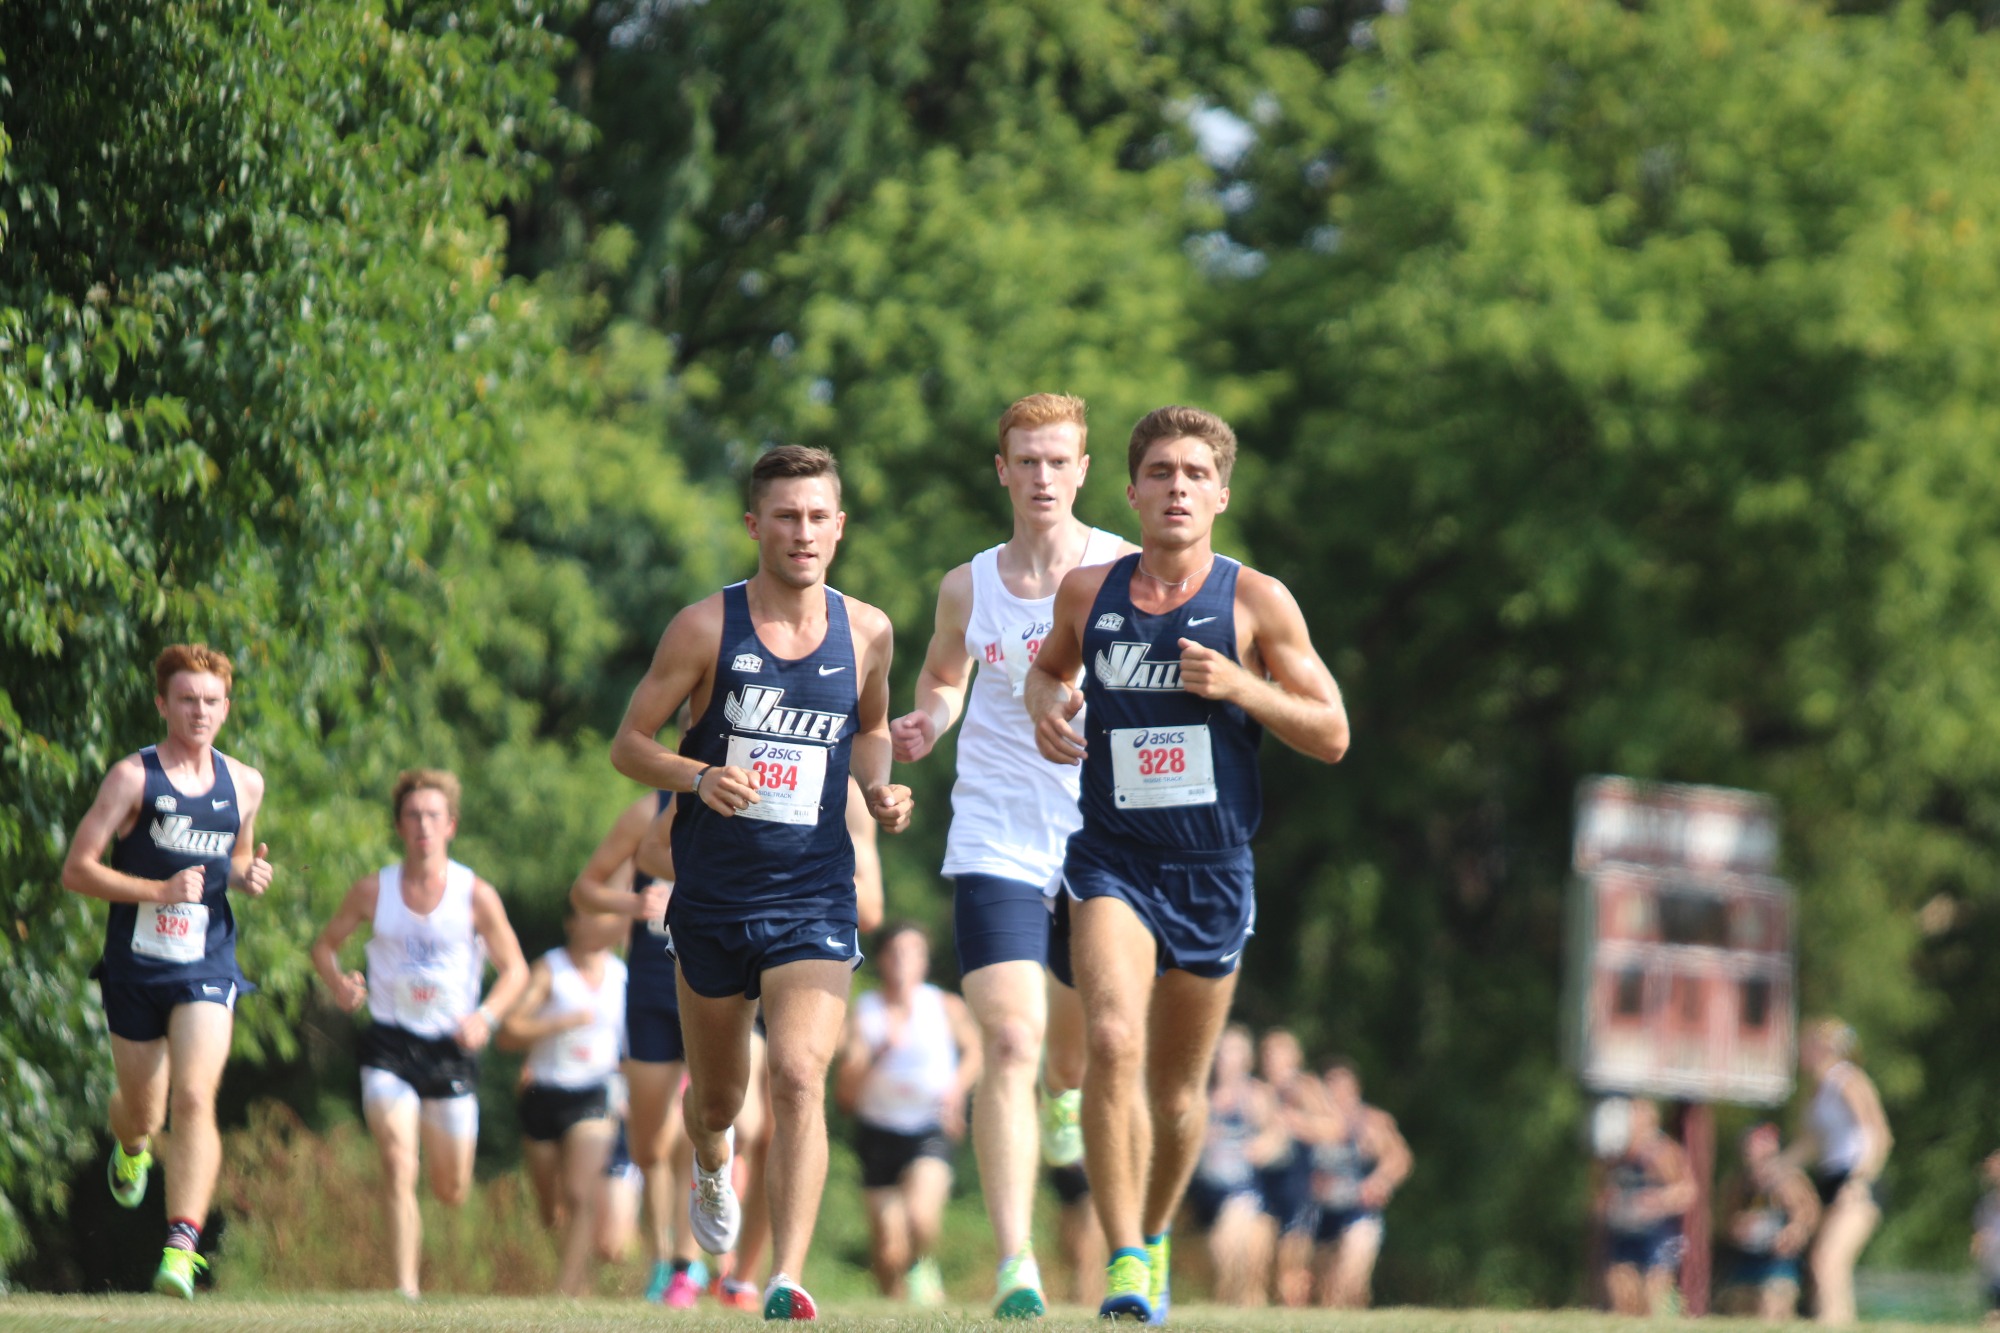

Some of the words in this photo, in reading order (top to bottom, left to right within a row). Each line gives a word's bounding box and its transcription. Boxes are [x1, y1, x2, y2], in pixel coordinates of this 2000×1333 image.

[1104, 643, 1186, 688] VALL
[735, 685, 847, 741] VALLEY
[1149, 732, 1185, 745] asics
[767, 747, 802, 761] asics
[1138, 747, 1185, 775] 328
[752, 760, 798, 791] 334
[156, 913, 189, 937] 329
